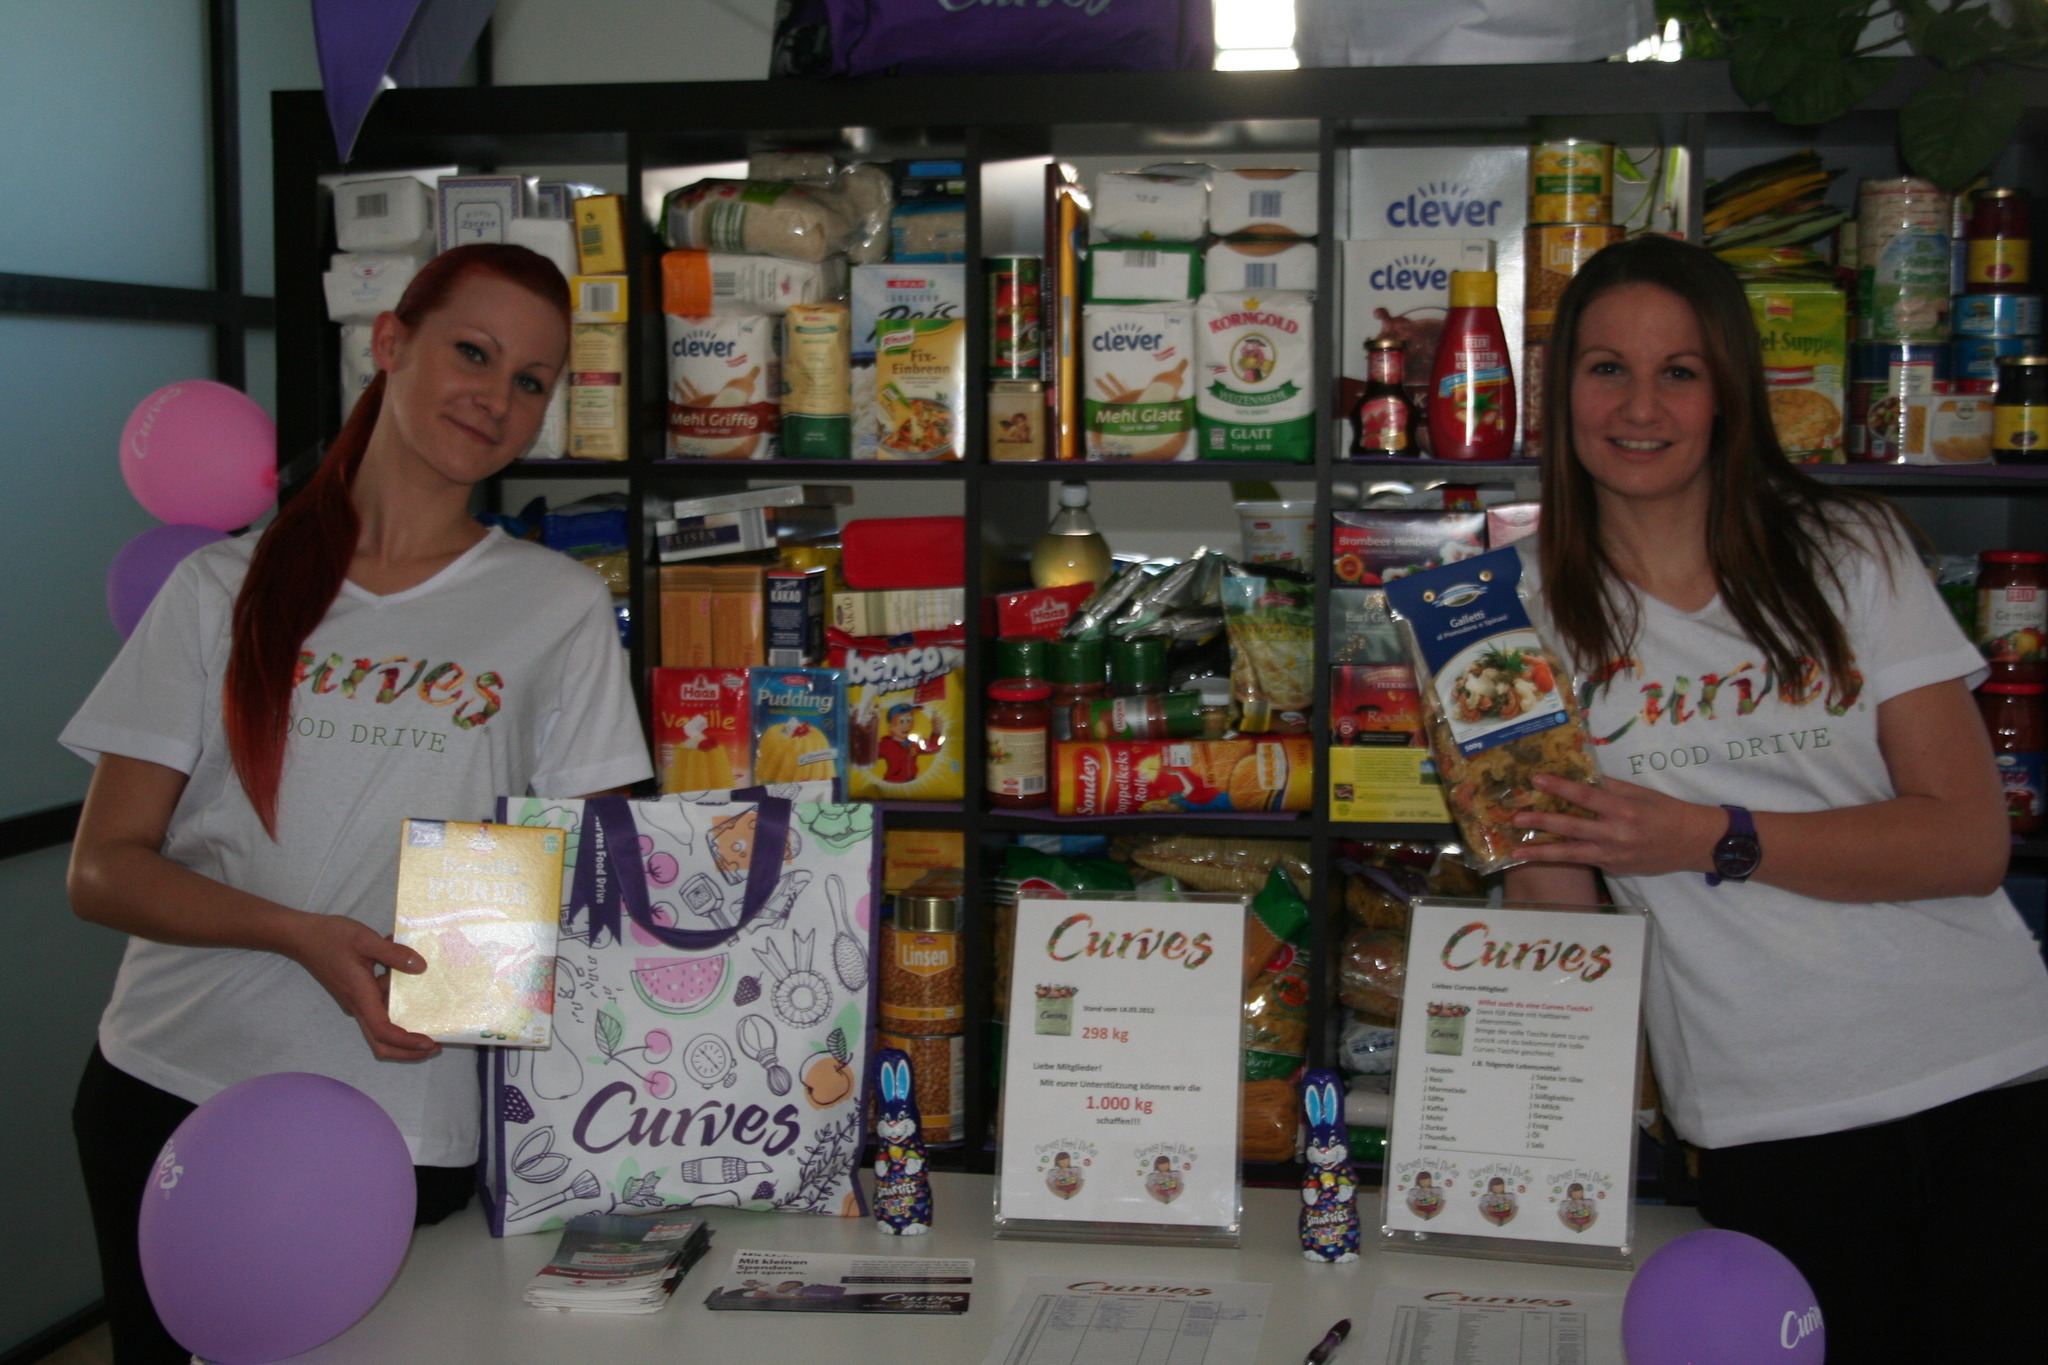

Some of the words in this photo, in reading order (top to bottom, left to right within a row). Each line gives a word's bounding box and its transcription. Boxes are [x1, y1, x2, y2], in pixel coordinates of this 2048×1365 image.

[1385, 194, 1502, 228] clever
[1369, 264, 1457, 291] cleve
[1208, 312, 1299, 334] KORNGOLD
[672, 336, 737, 358] clever
[1092, 332, 1163, 351] clever
[910, 350, 937, 363] Fix-
[892, 363, 950, 375] Einbrenn
[671, 412, 706, 427] Mehl
[709, 413, 759, 429] Griffig
[1096, 408, 1137, 425] Mehl
[1141, 407, 1183, 423] Glatt
[1230, 428, 1273, 441] GLATT
[769, 591, 801, 603] KAKAO
[1033, 609, 1067, 621] Haas
[1346, 611, 1368, 623] Earl
[1450, 609, 1486, 628] Galletti
[845, 646, 943, 686] benco
[683, 687, 717, 699] Haas
[757, 688, 834, 713] Pudding
[661, 710, 737, 730] Vaille
[350, 723, 447, 753] DRIVE
[1464, 741, 1483, 753] 500g
[1626, 745, 1710, 776] FOOD
[1726, 726, 1832, 763] DRIVE
[1076, 754, 1102, 817] Sondey
[595, 851, 607, 875] Food
[595, 877, 607, 905] Drive
[1045, 912, 1214, 970] Curves
[902, 944, 949, 967] Linsen
[1440, 922, 1614, 984] Curves
[1082, 1027, 1108, 1040] 298
[1113, 1027, 1129, 1044] kg
[1033, 1063, 1055, 1071] Liebe
[1057, 1063, 1102, 1073] Mitglieder!
[1039, 1079, 1054, 1087] Mit
[1080, 1080, 1138, 1092] Unterstützung
[1139, 1082, 1171, 1091] können
[1086, 1096, 1130, 1110] 1.000
[1135, 1097, 1155, 1114] kg
[572, 1080, 801, 1158] Curves
[1306, 1210, 1349, 1227] SMARTIES
[1065, 1280, 1212, 1297] Curves
[880, 1293, 965, 1303] Curves
[1423, 1291, 1572, 1308] Curves
